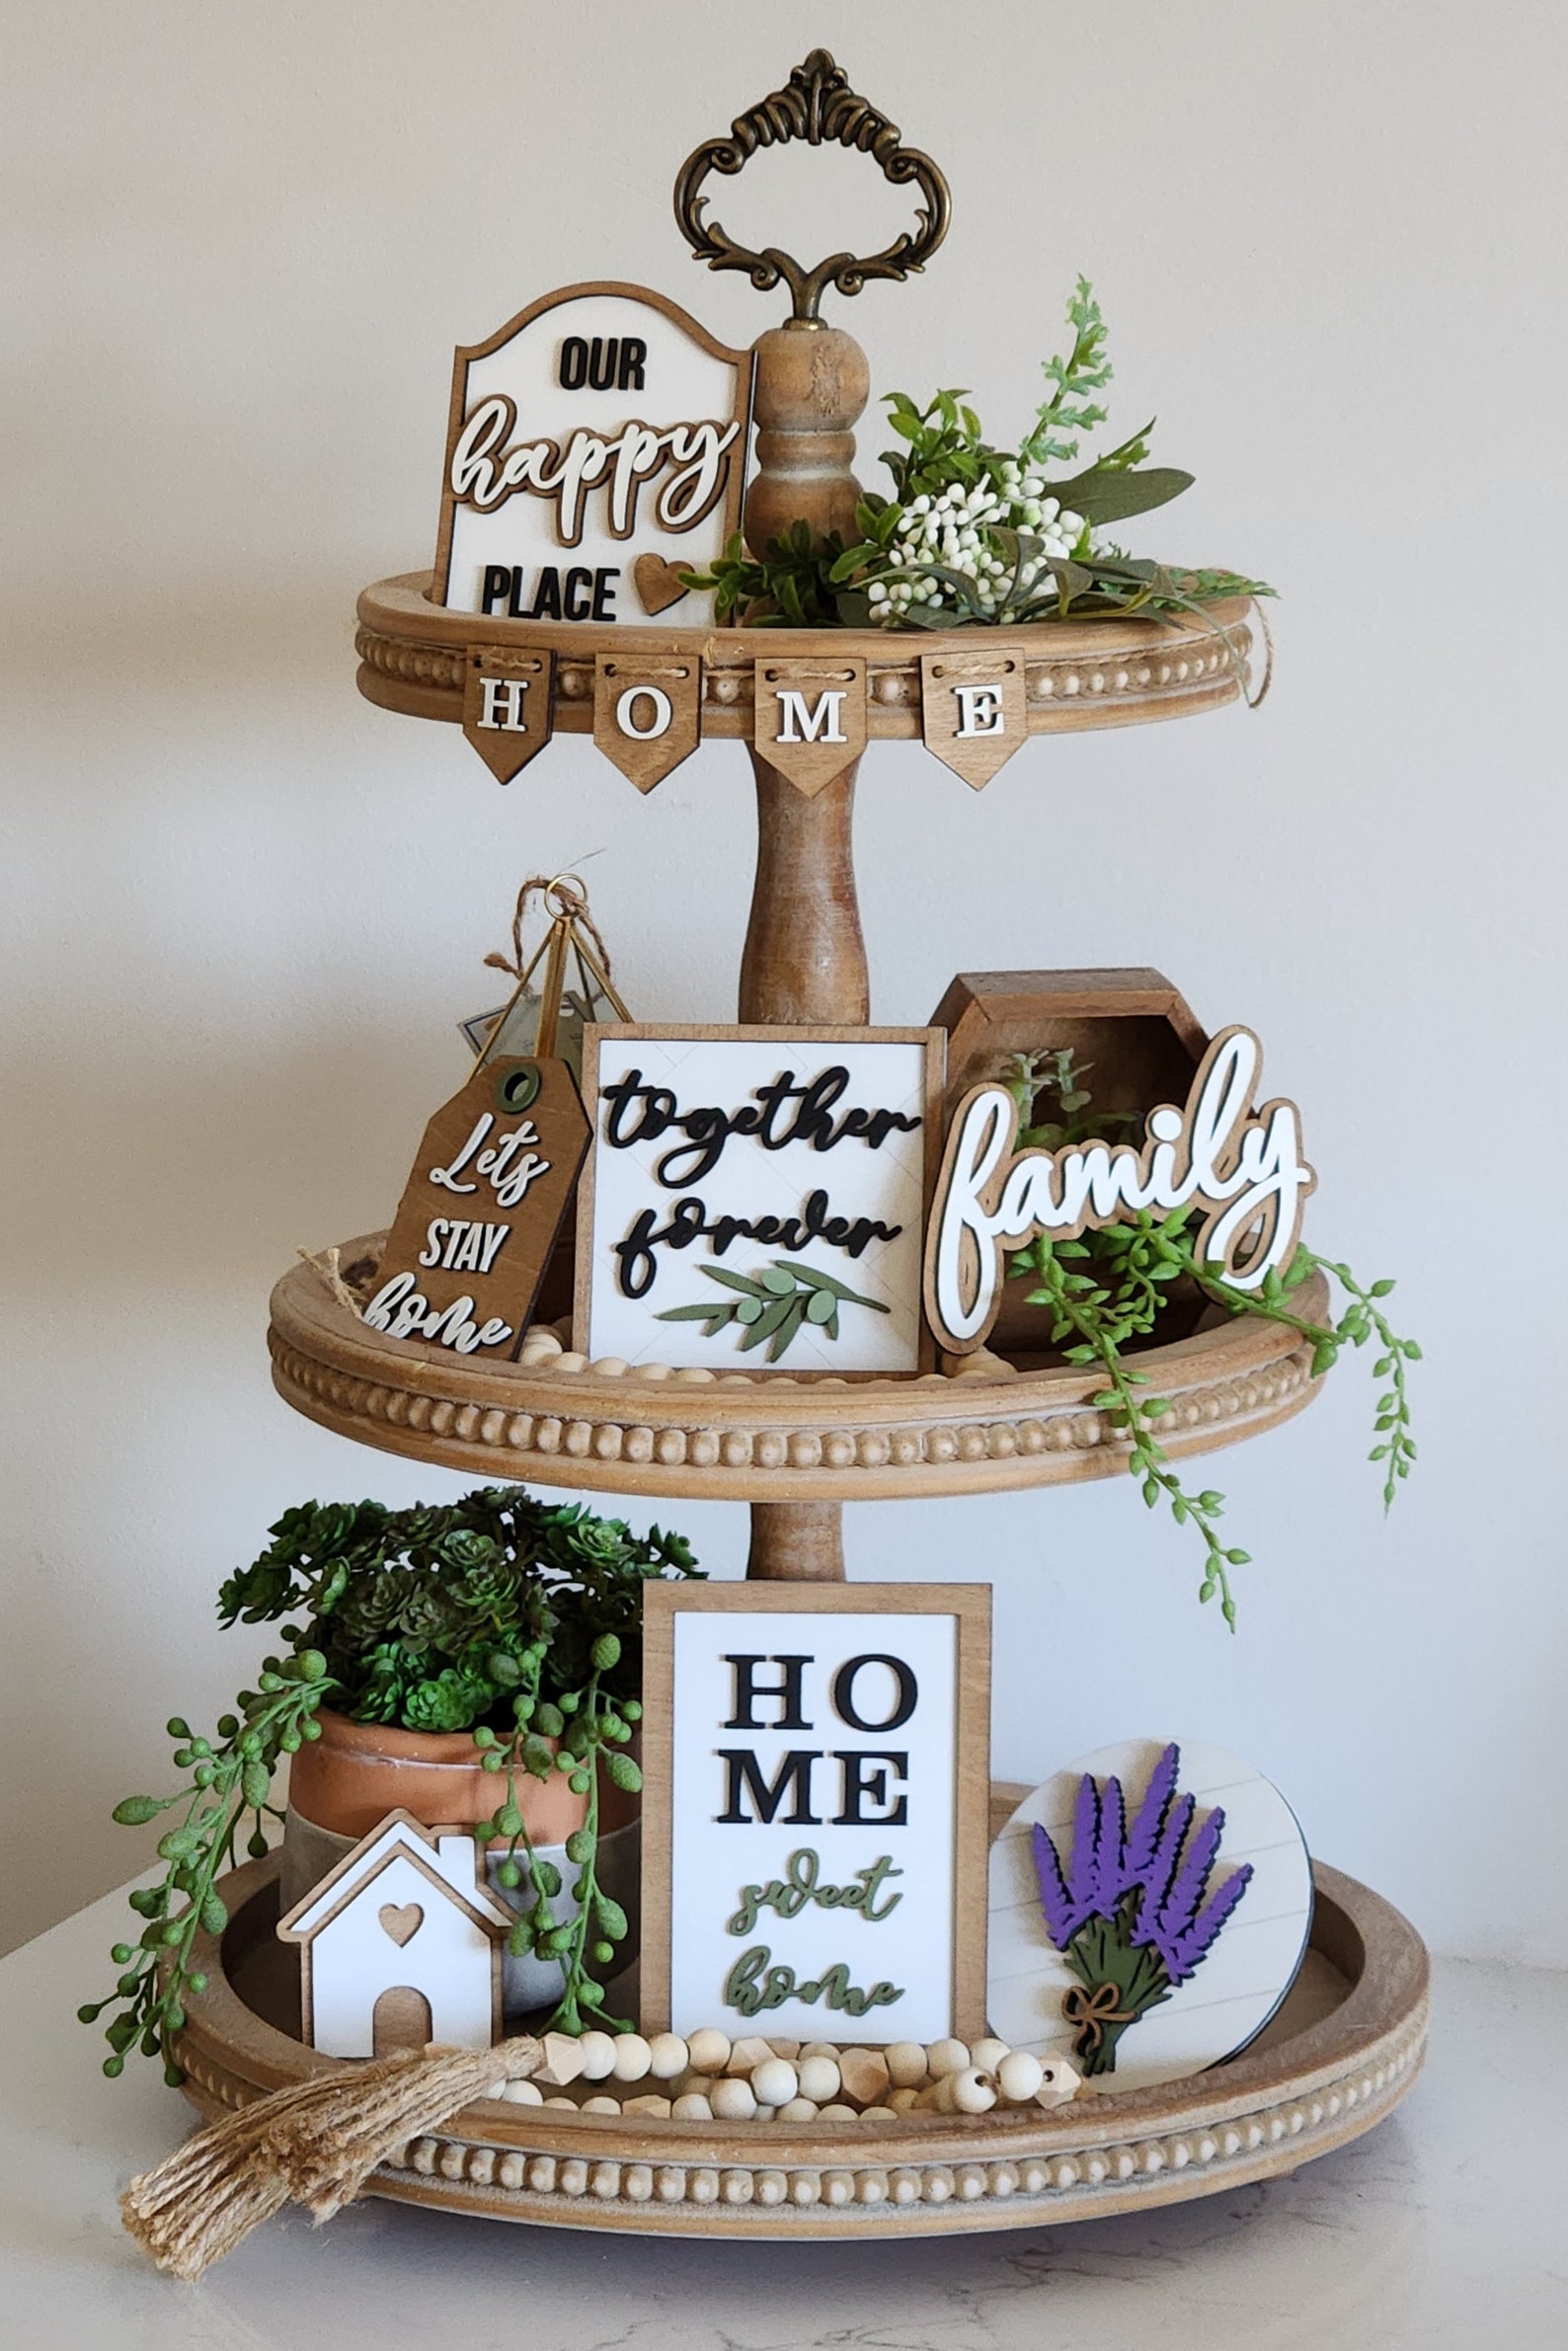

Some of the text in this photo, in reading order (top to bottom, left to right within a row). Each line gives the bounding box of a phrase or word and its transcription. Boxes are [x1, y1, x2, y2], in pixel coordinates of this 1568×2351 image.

[560, 337, 647, 391] OUR
[451, 398, 742, 542] happy
[481, 565, 621, 622] PLACE
[429, 1112, 551, 1208] Lets
[602, 1065, 922, 1189] together
[937, 1033, 1312, 1340] family
[419, 1217, 510, 1273] STAY
[616, 1189, 902, 1299] forever
[363, 1271, 513, 1354] home
[723, 1653, 918, 1733] HO
[716, 1749, 909, 1827] ME
[728, 1847, 904, 1937] sweet
[726, 1945, 905, 2018] home
